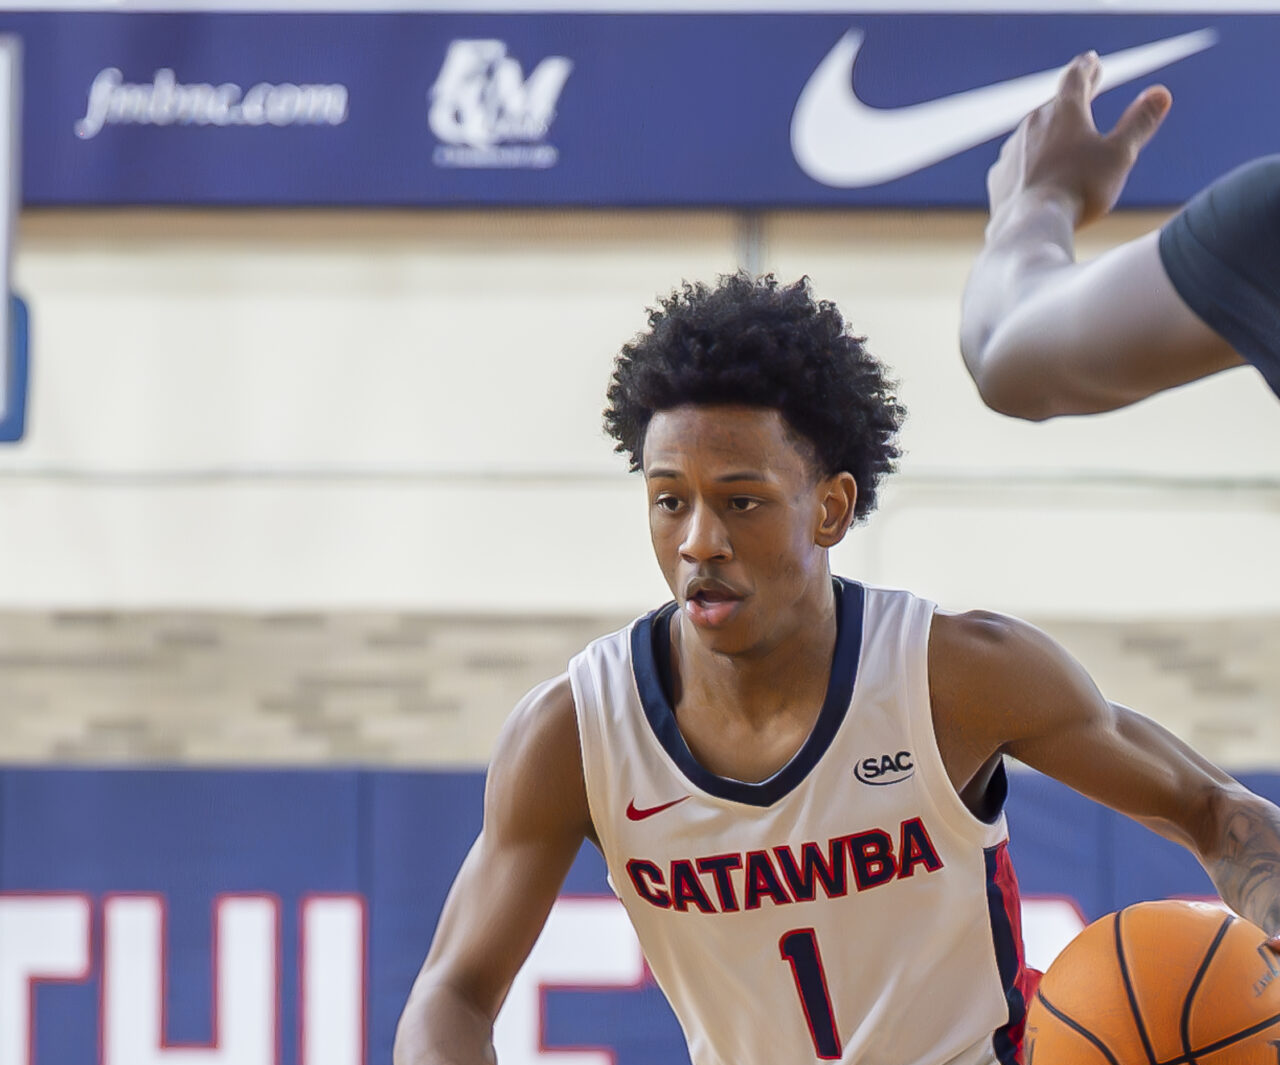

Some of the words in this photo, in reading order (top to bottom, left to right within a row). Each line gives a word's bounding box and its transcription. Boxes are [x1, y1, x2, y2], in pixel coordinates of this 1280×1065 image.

[862, 750, 914, 779] SAC
[625, 816, 944, 914] CATAWBA
[779, 927, 843, 1061] 1
